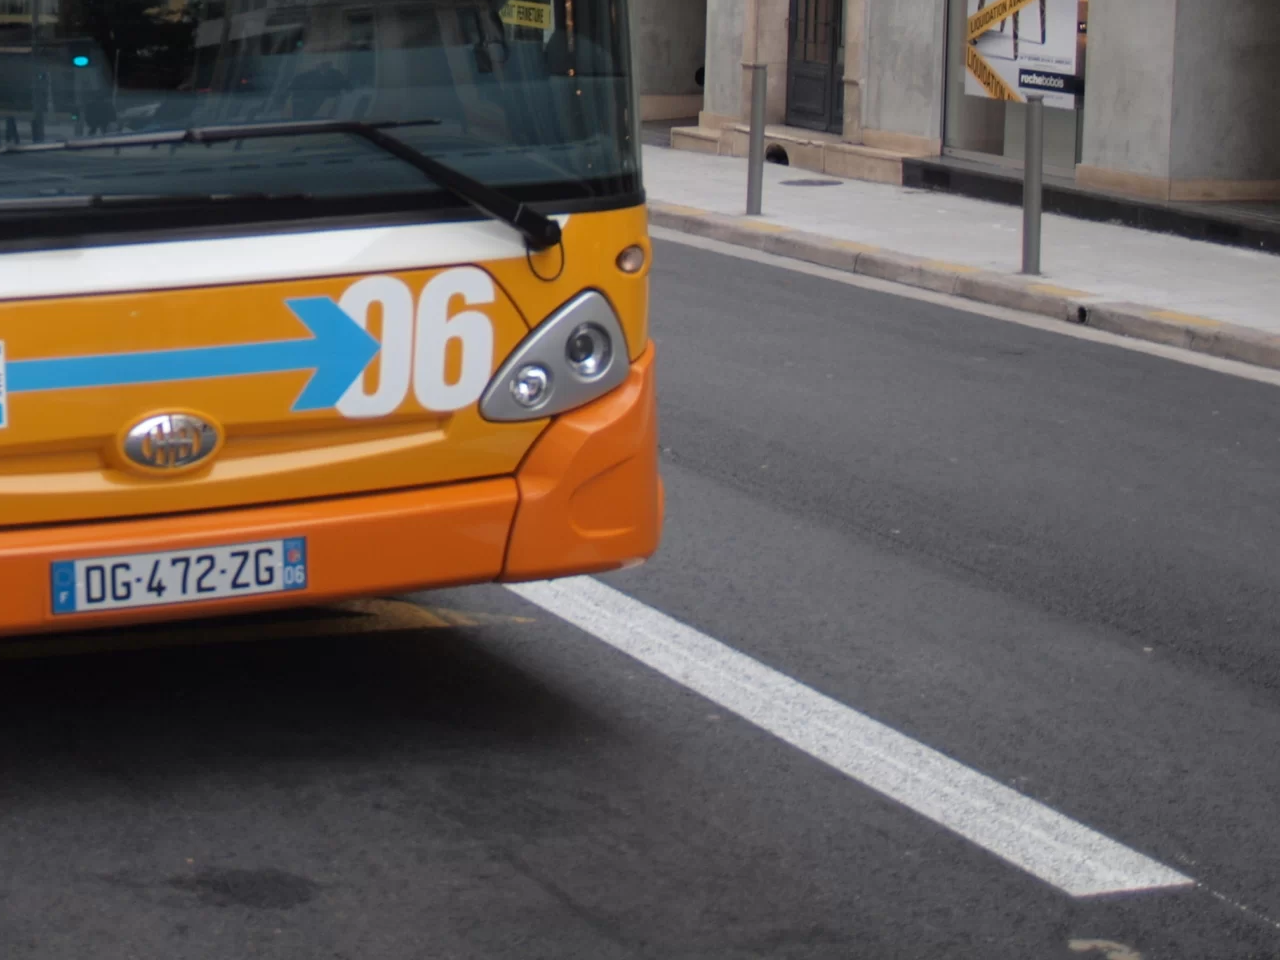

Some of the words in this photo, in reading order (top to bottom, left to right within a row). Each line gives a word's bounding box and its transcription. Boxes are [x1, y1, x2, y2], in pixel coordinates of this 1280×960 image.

[970, 1, 1008, 34] LIQUIDATION
[336, 265, 496, 419] 06
[283, 565, 305, 585] 06
[60, 591, 69, 604] F
